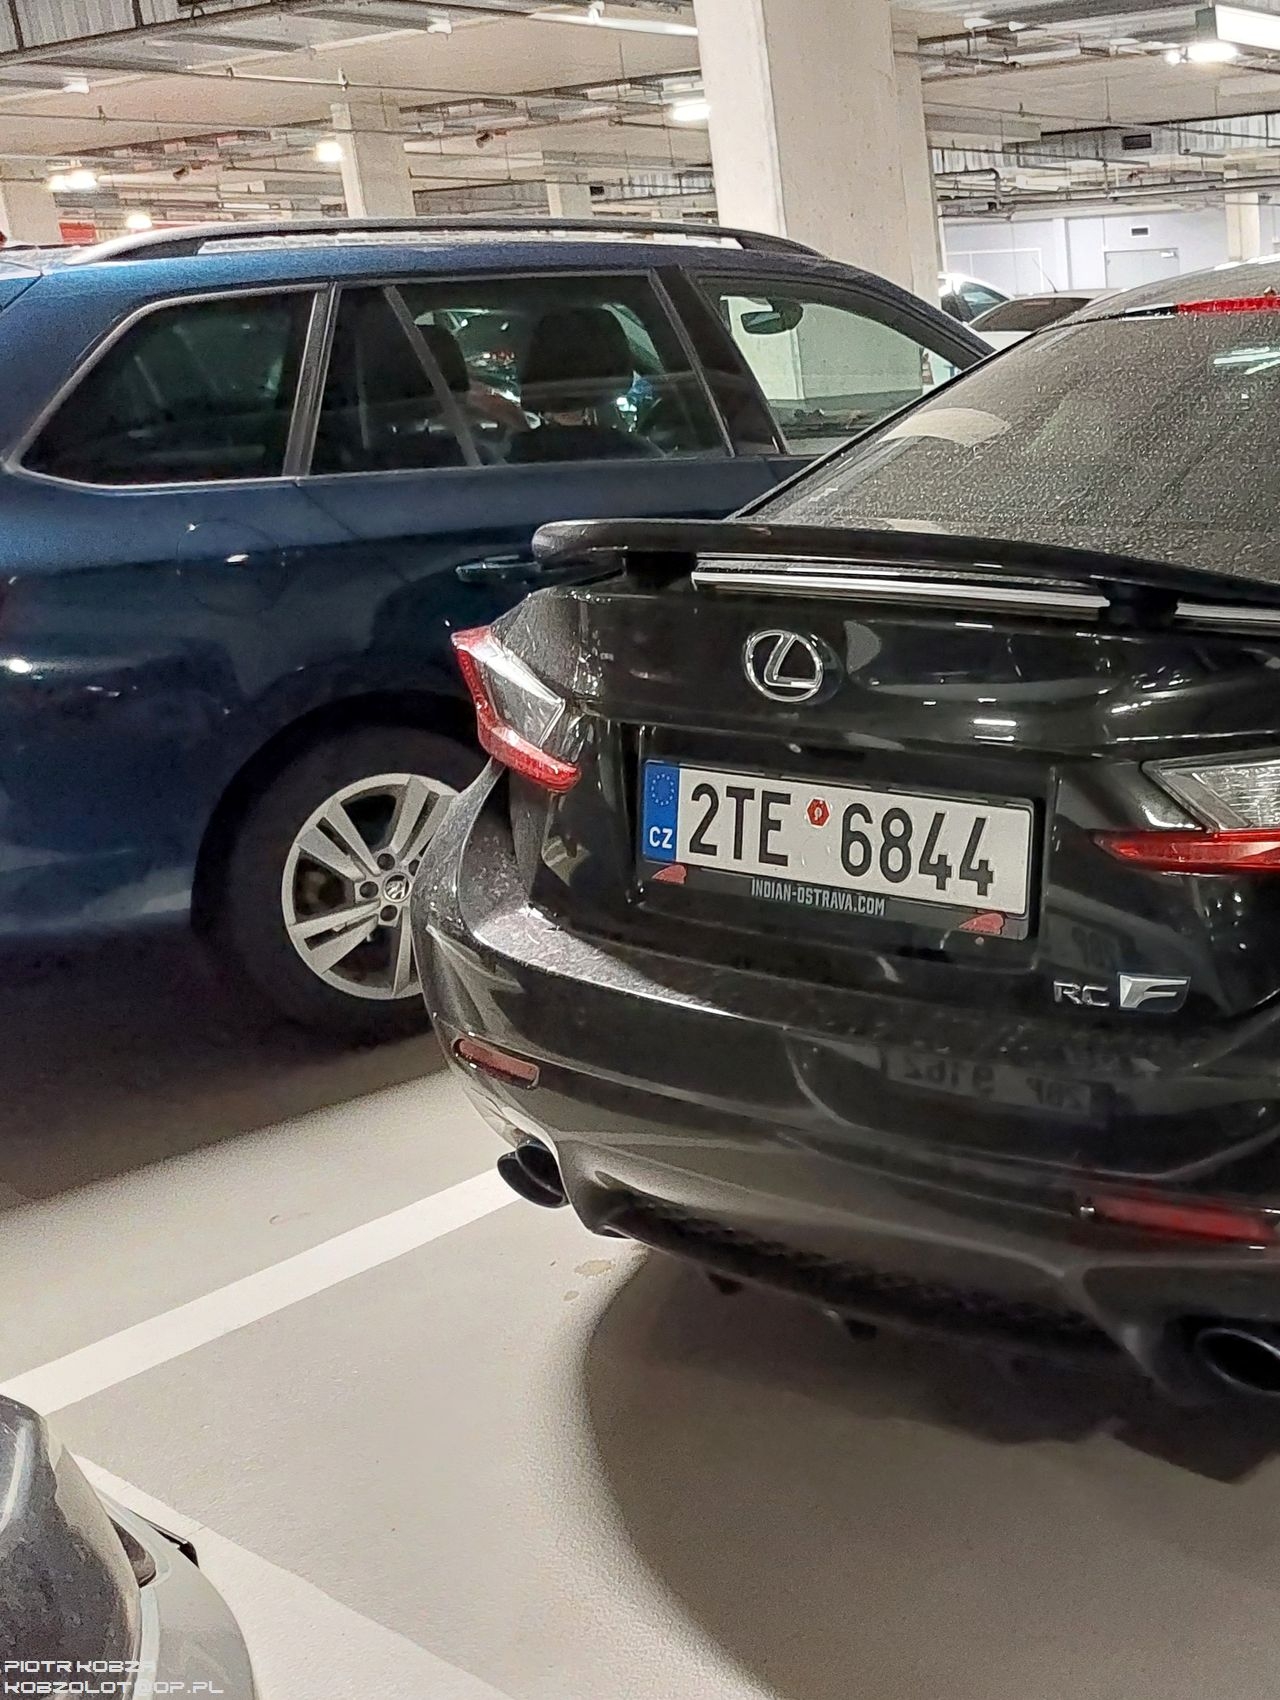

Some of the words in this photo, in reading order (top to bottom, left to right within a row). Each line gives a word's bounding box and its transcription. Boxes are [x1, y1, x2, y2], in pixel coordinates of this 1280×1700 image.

[649, 826, 673, 849] CZ
[688, 782, 792, 867] 2TE
[839, 802, 996, 899] 6844
[751, 878, 886, 917] INDIAN-OSTRAVA.COM
[1053, 980, 1110, 1007] RC
